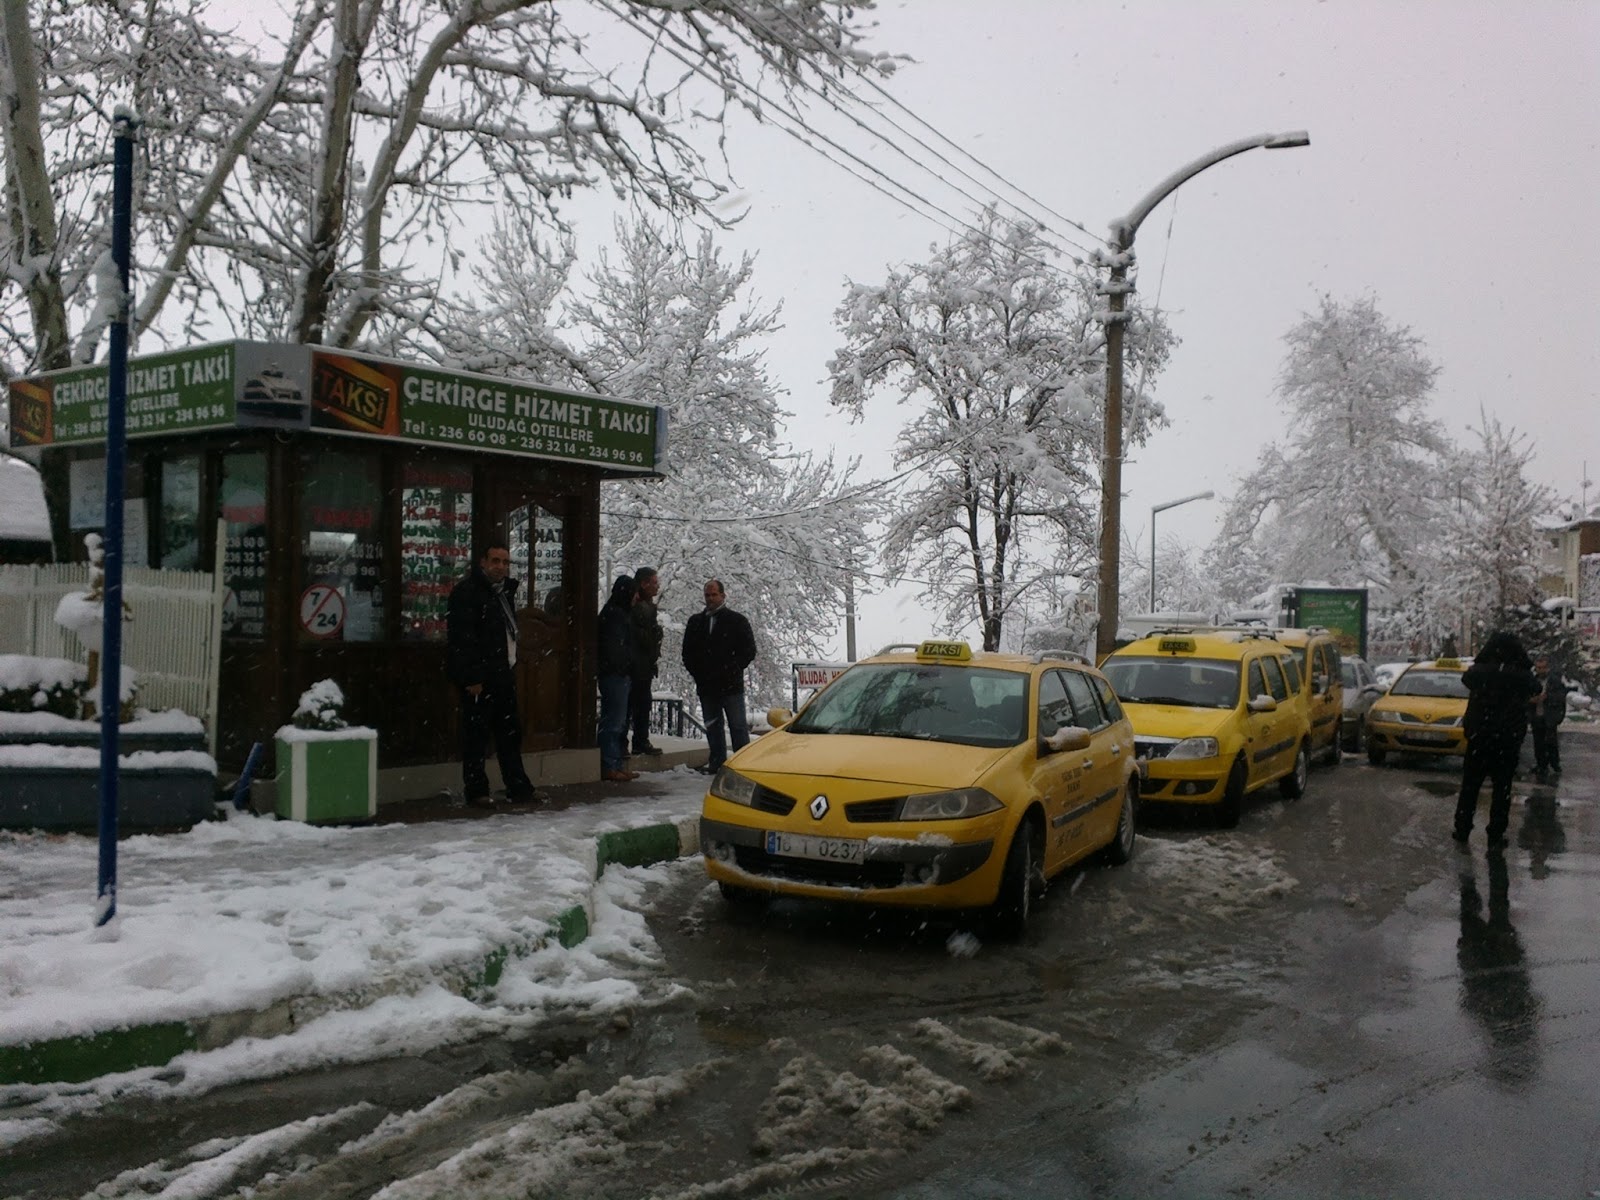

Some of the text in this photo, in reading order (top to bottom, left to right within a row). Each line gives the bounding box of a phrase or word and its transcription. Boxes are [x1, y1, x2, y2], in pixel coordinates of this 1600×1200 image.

[53, 374, 109, 412] ÇEKİRG
[182, 348, 230, 386] TAKSİ
[318, 367, 385, 422] TAKSİ
[403, 376, 650, 435] ÇEKİRGE HİZMET TAKSİ
[403, 419, 425, 434] Tel
[438, 425, 464, 439] 236
[468, 429, 486, 442] 60
[490, 433, 507, 446] 08
[520, 437, 543, 450] 236
[546, 440, 560, 452] 32
[564, 443, 576, 455] 14
[589, 446, 609, 459] 234
[612, 449, 626, 461] 96
[630, 451, 643, 463] 96
[468, 413, 594, 443] ULUDAĞ OTELLERE
[360, 566, 376, 576] 96
[310, 592, 320, 606] 7
[317, 613, 337, 627] 24
[819, 840, 860, 861] 0237
